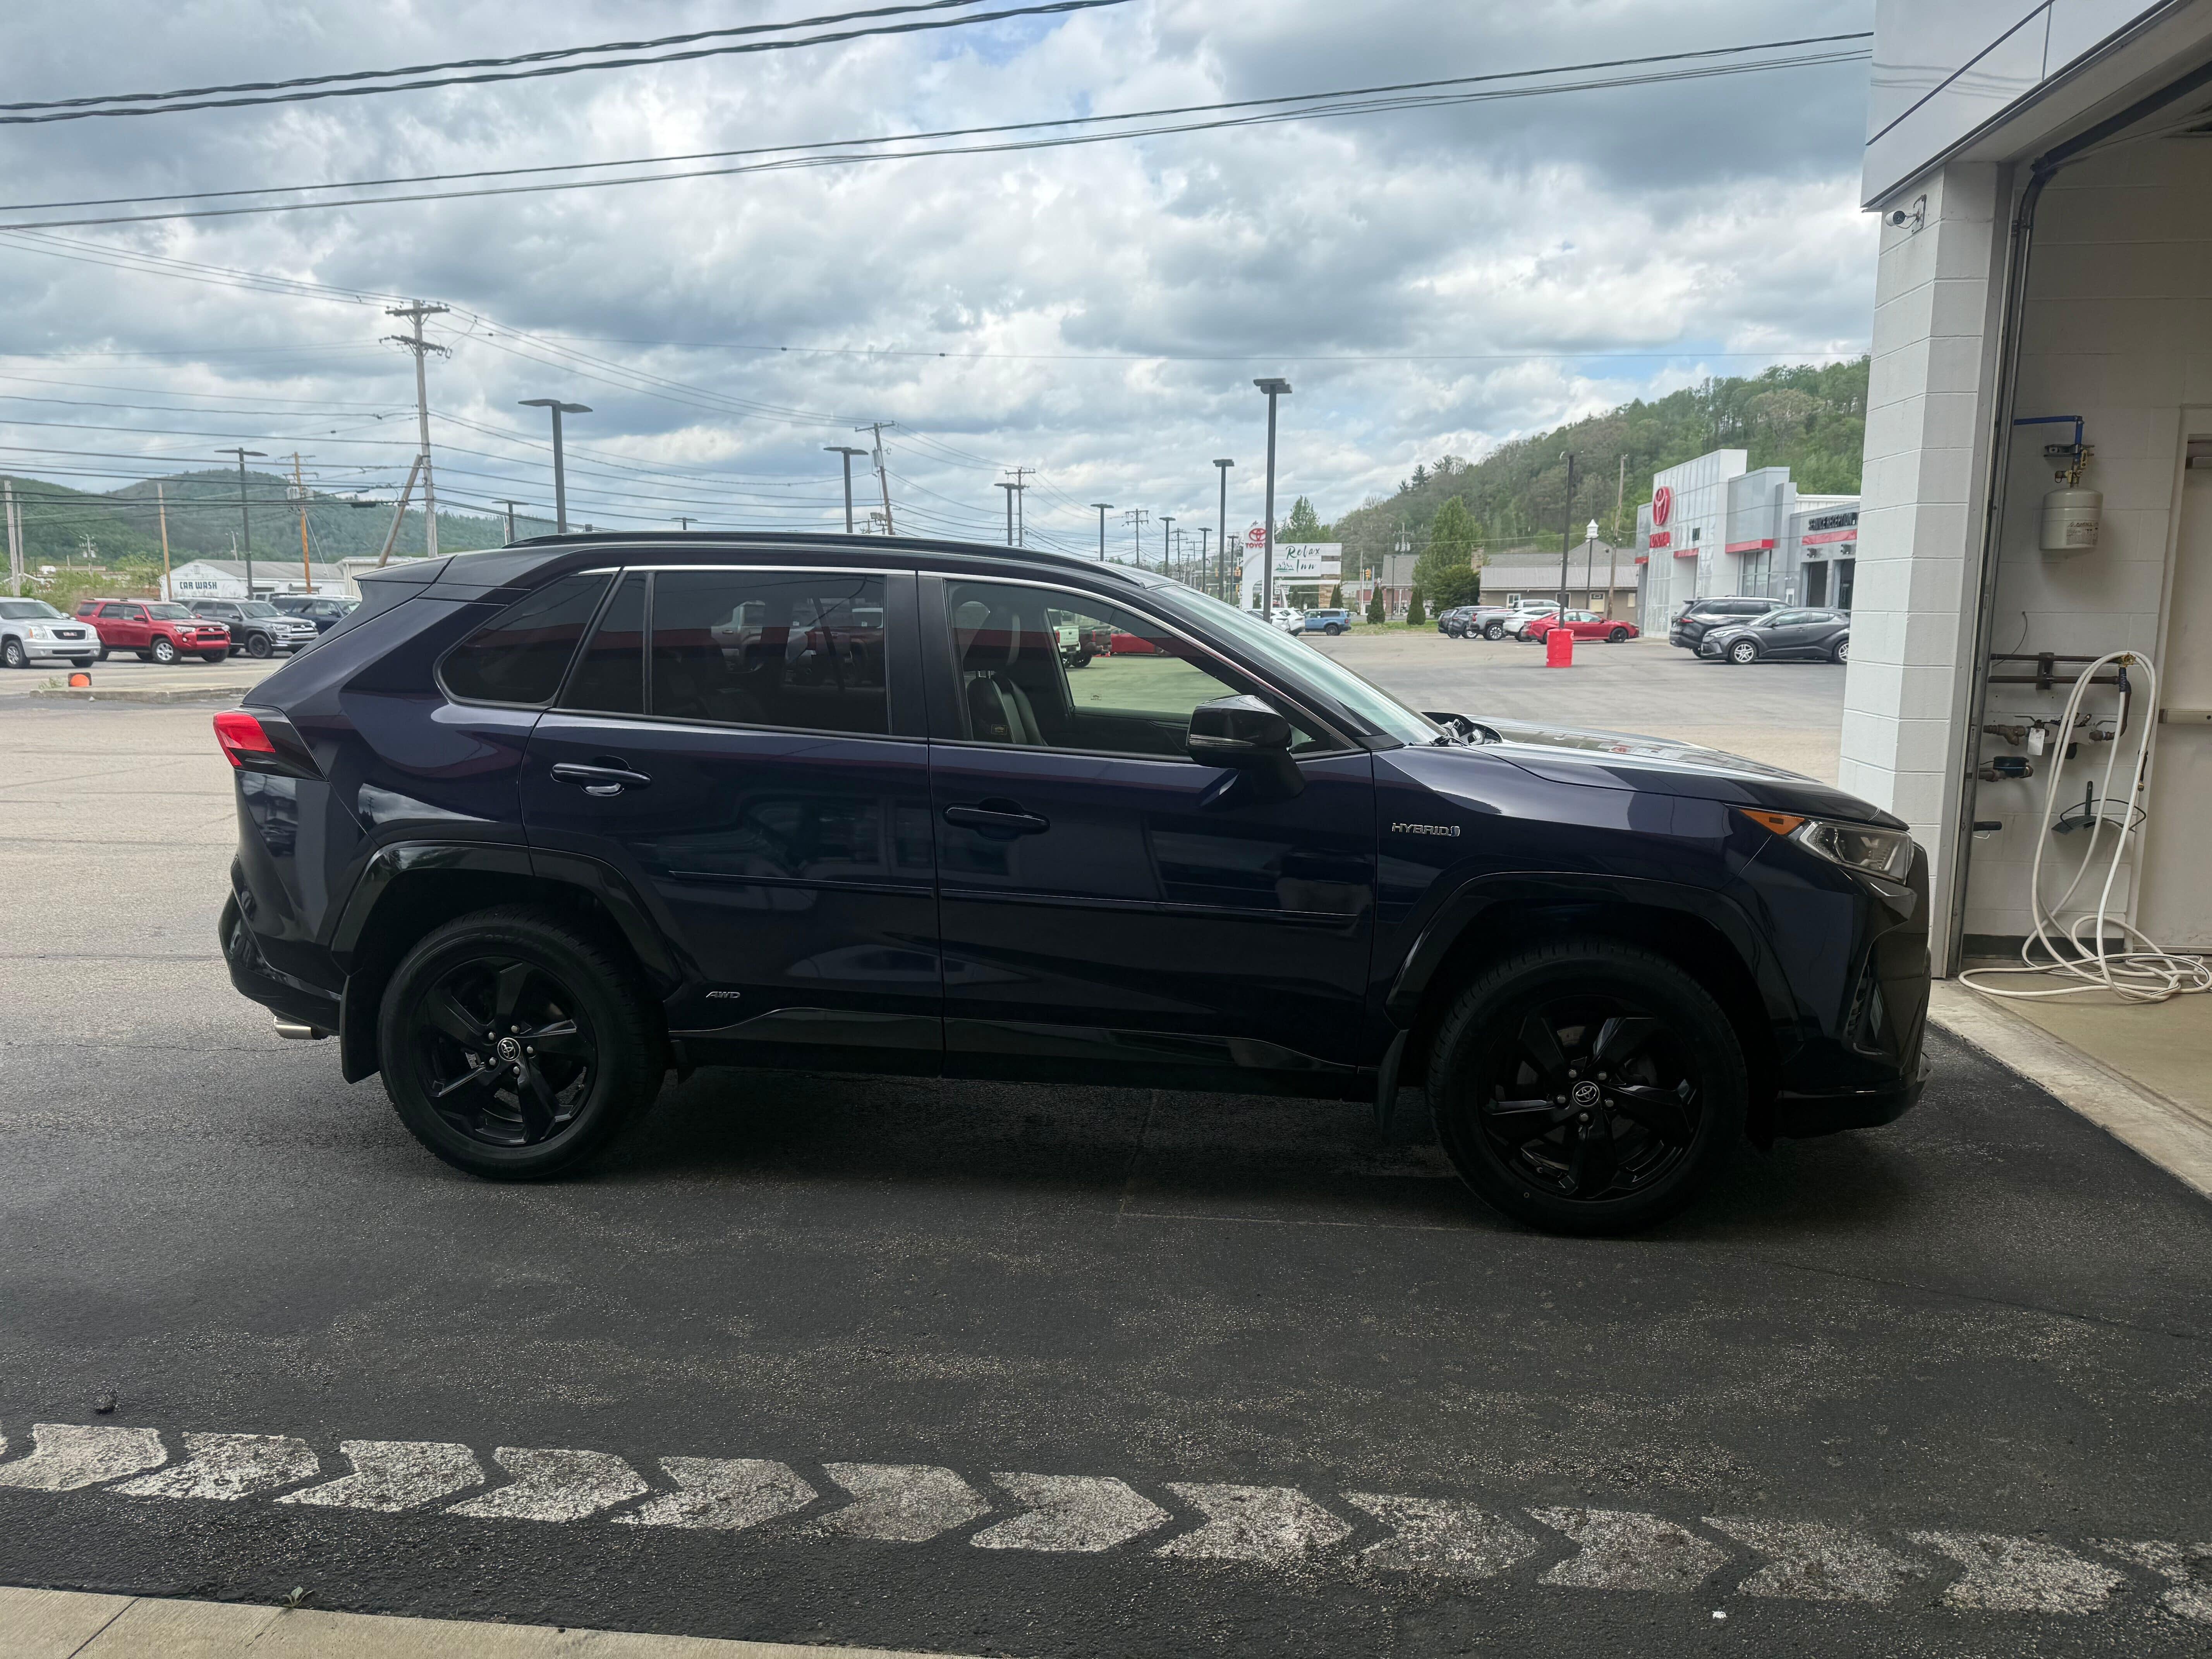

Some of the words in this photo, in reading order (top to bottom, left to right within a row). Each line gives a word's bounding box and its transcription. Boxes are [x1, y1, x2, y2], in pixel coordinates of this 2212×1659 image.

[1286, 545, 1320, 560] Relax
[1296, 559, 1316, 573] Inn
[1392, 823, 1449, 836] HYBRID
